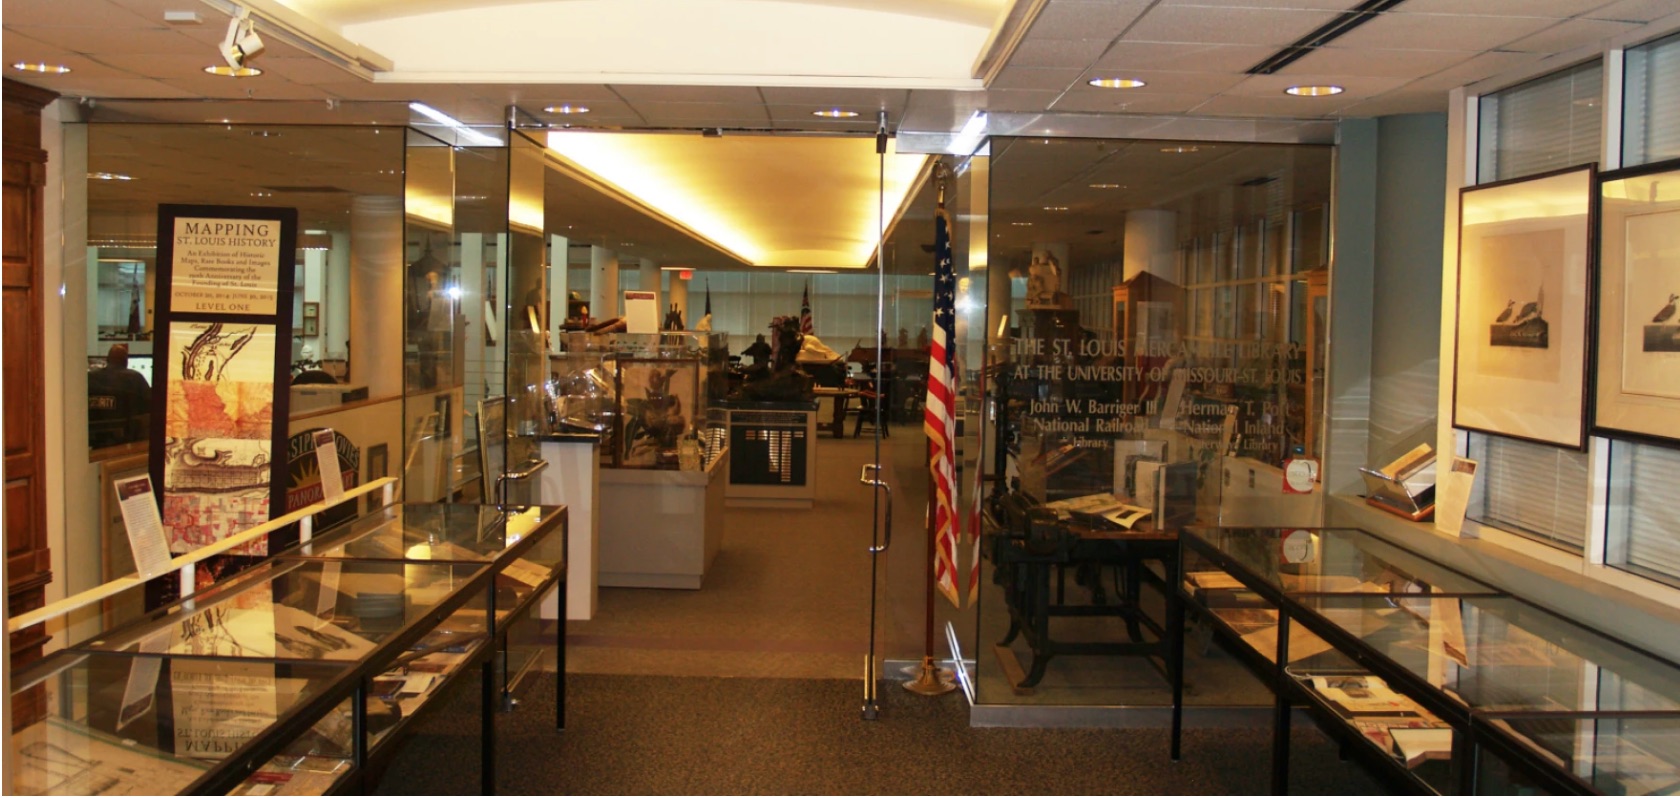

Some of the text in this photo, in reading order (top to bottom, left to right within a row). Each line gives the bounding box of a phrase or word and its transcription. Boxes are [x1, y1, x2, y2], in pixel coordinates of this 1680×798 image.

[185, 222, 269, 237] MAPPING
[177, 236, 276, 248] ST. LOUIS HISTORY
[194, 266, 245, 274] Commemorating
[205, 272, 246, 280] Anniversary
[196, 302, 251, 312] LEVEL ONE
[1014, 338, 1045, 356] THE
[1053, 338, 1073, 356] ST.
[1080, 339, 1125, 356] LOUIS
[1014, 366, 1030, 380] AT
[1037, 366, 1062, 381] THE
[1067, 366, 1144, 382] UNIVERSITY
[1030, 399, 1059, 416] John
[1066, 400, 1082, 414] W.
[1088, 400, 1139, 418] Barriger
[1182, 400, 1232, 416] Herma
[1245, 401, 1255, 416] T.
[1034, 418, 1090, 433] National
[1185, 420, 1285, 435] Natiol Inland
[1074, 436, 1109, 450] Library
[1244, 439, 1278, 451] Library
